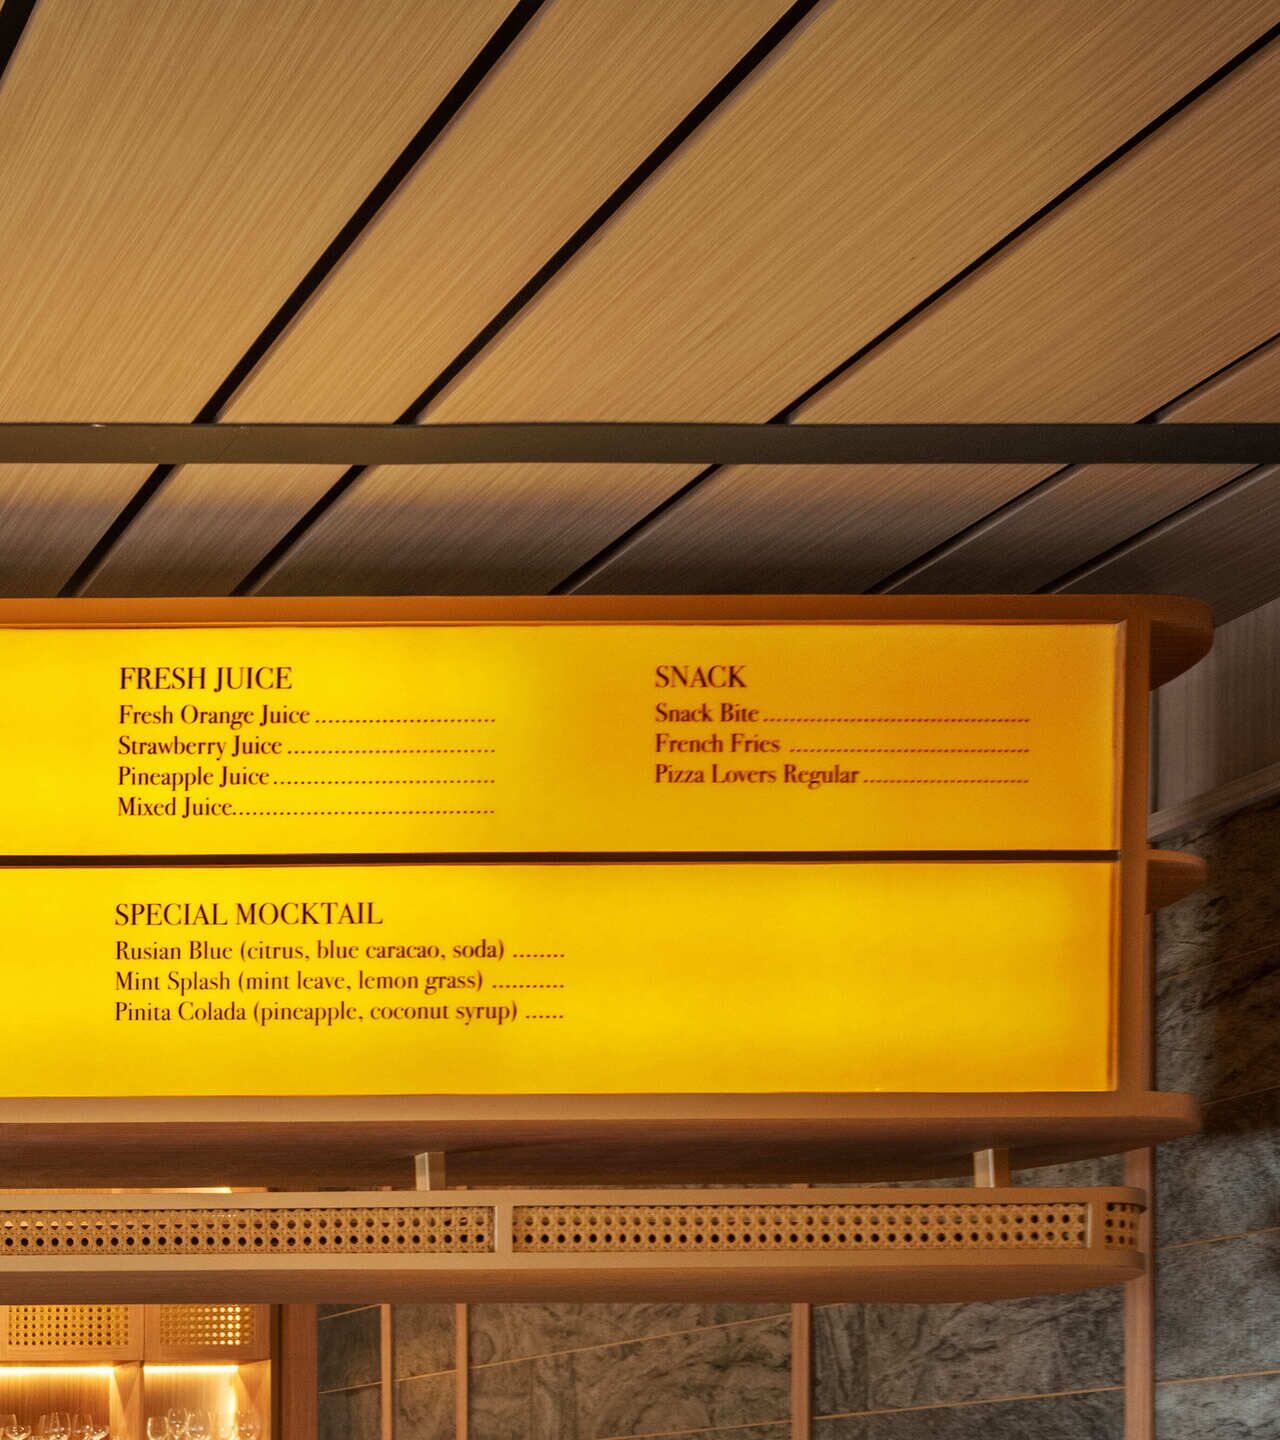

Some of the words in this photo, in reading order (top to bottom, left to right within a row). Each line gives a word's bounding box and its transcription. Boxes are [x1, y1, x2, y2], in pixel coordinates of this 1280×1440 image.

[120, 667, 206, 689] FRESH
[214, 667, 292, 692] JUICE
[655, 665, 747, 688] SNACK
[120, 705, 173, 724] Fresh
[181, 705, 254, 730] Orange
[259, 704, 310, 727] Juice
[656, 703, 714, 722] Snack
[720, 703, 760, 722] Bite
[118, 736, 226, 761] Strawberry
[232, 735, 282, 757] Juice
[656, 733, 723, 752] French
[731, 733, 780, 752] Fries
[119, 766, 213, 791] Pineapple
[219, 766, 269, 788] Juice
[656, 764, 705, 783] Pizza
[712, 764, 777, 783] Lovers
[784, 764, 860, 790] Regular
[118, 797, 176, 816] Mixed
[182, 797, 232, 818] Juice
[115, 903, 227, 926] SPECIAL
[237, 902, 383, 925] MOCKTAIL
[116, 941, 181, 960] Rusian
[190, 941, 232, 959] Blue
[241, 941, 309, 961] (citrus,
[317, 940, 359, 958] blue
[366, 946, 445, 960] caracao,
[453, 939, 504, 960] soda)
[116, 971, 159, 990] Mint
[168, 971, 230, 996] Splash
[238, 972, 288, 992] (mint
[298, 971, 351, 990] leave,
[359, 970, 418, 989] lemon
[424, 971, 483, 995] grass)
[116, 1002, 171, 1021] Pinita
[178, 1001, 246, 1020] Colada
[254, 1001, 363, 1026] (pineapple,
[370, 1006, 448, 1019] coconut
[456, 1002, 517, 1025] syrup)
